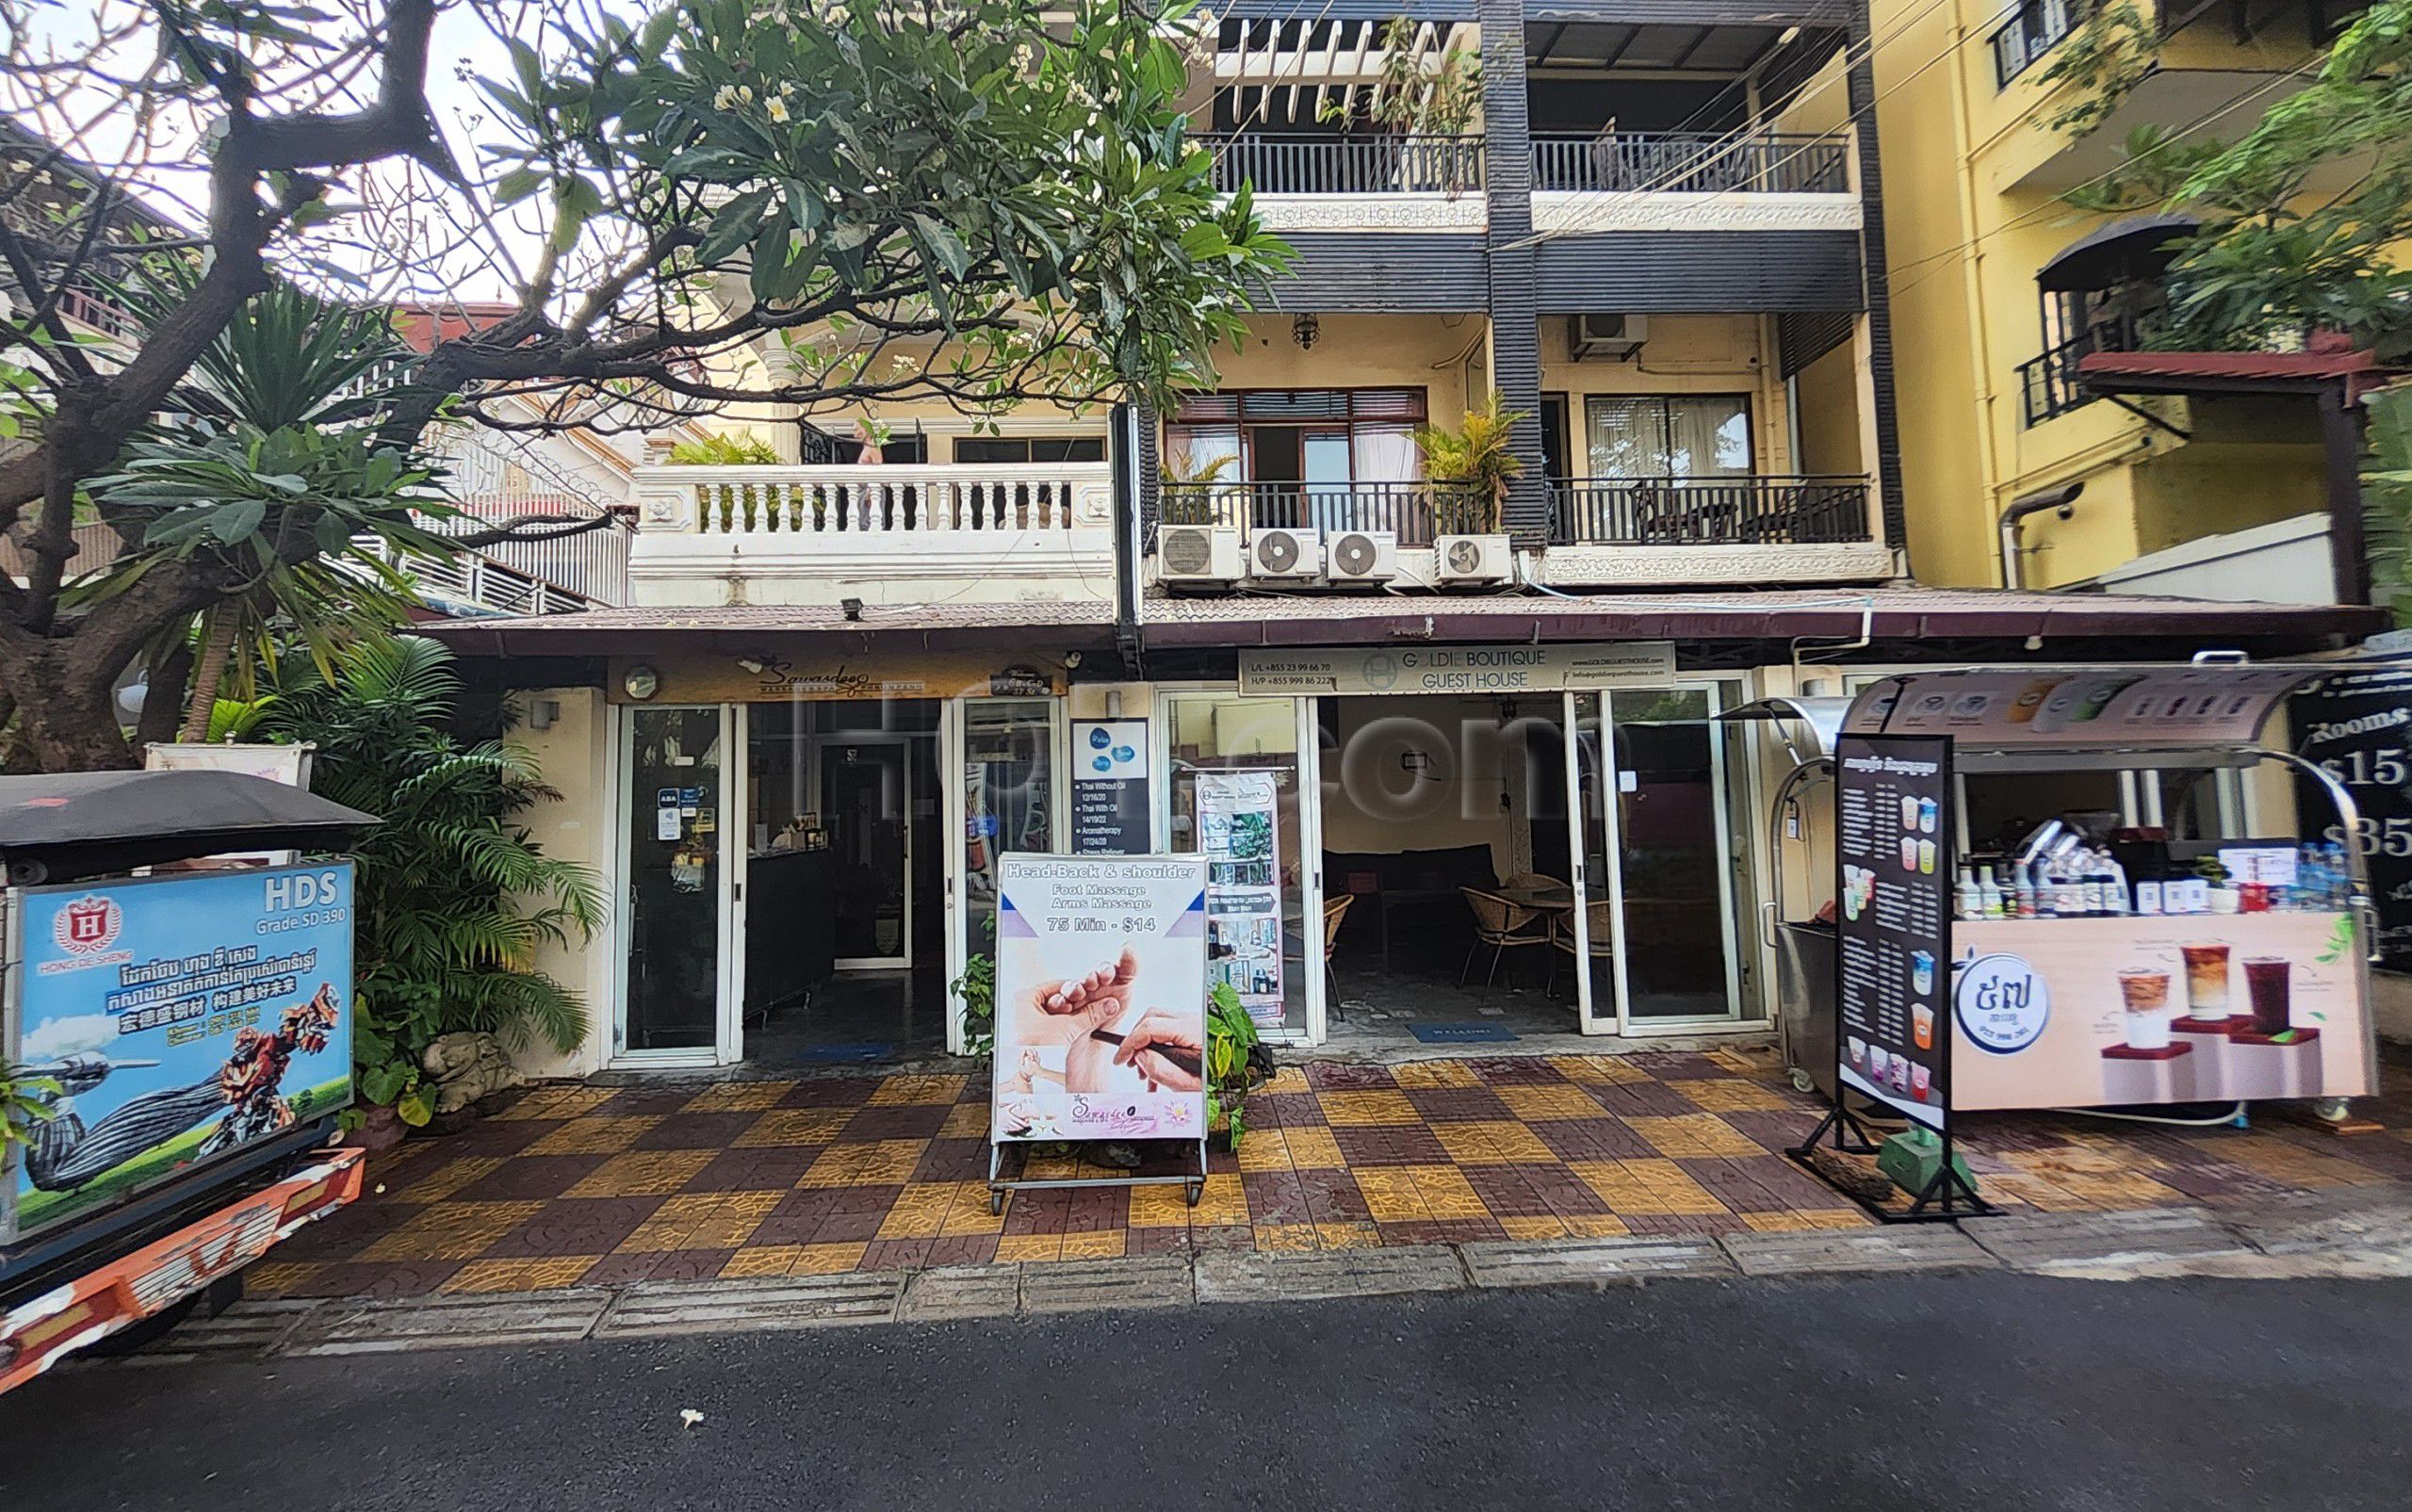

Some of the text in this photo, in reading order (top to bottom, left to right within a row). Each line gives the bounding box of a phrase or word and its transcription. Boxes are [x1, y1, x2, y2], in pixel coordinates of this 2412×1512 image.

[1467, 650, 1546, 667] BOUTIQUE
[1265, 663, 1285, 672] +855
[1286, 663, 1297, 672] 23
[1298, 663, 1309, 672] 99
[1321, 663, 1331, 672] 70
[1251, 676, 1266, 685] H/P
[1268, 676, 1288, 685] +855
[1422, 672, 1528, 689] GUEST HOUSE
[1095, 782, 1116, 790] Without
[1117, 782, 1126, 790] Oil
[1082, 827, 1122, 837] Aromatherapy
[1007, 863, 1197, 879] Head-Back & shoulder
[265, 871, 338, 913] HDS
[1052, 884, 1147, 898] Foot Massage
[1051, 898, 1152, 911] Arms Massage
[255, 908, 346, 935] Grade SD 390
[1047, 917, 1069, 932] 75
[1074, 917, 1107, 932] Min
[1122, 916, 1157, 934] $14
[214, 978, 297, 1011] 构建美好未来
